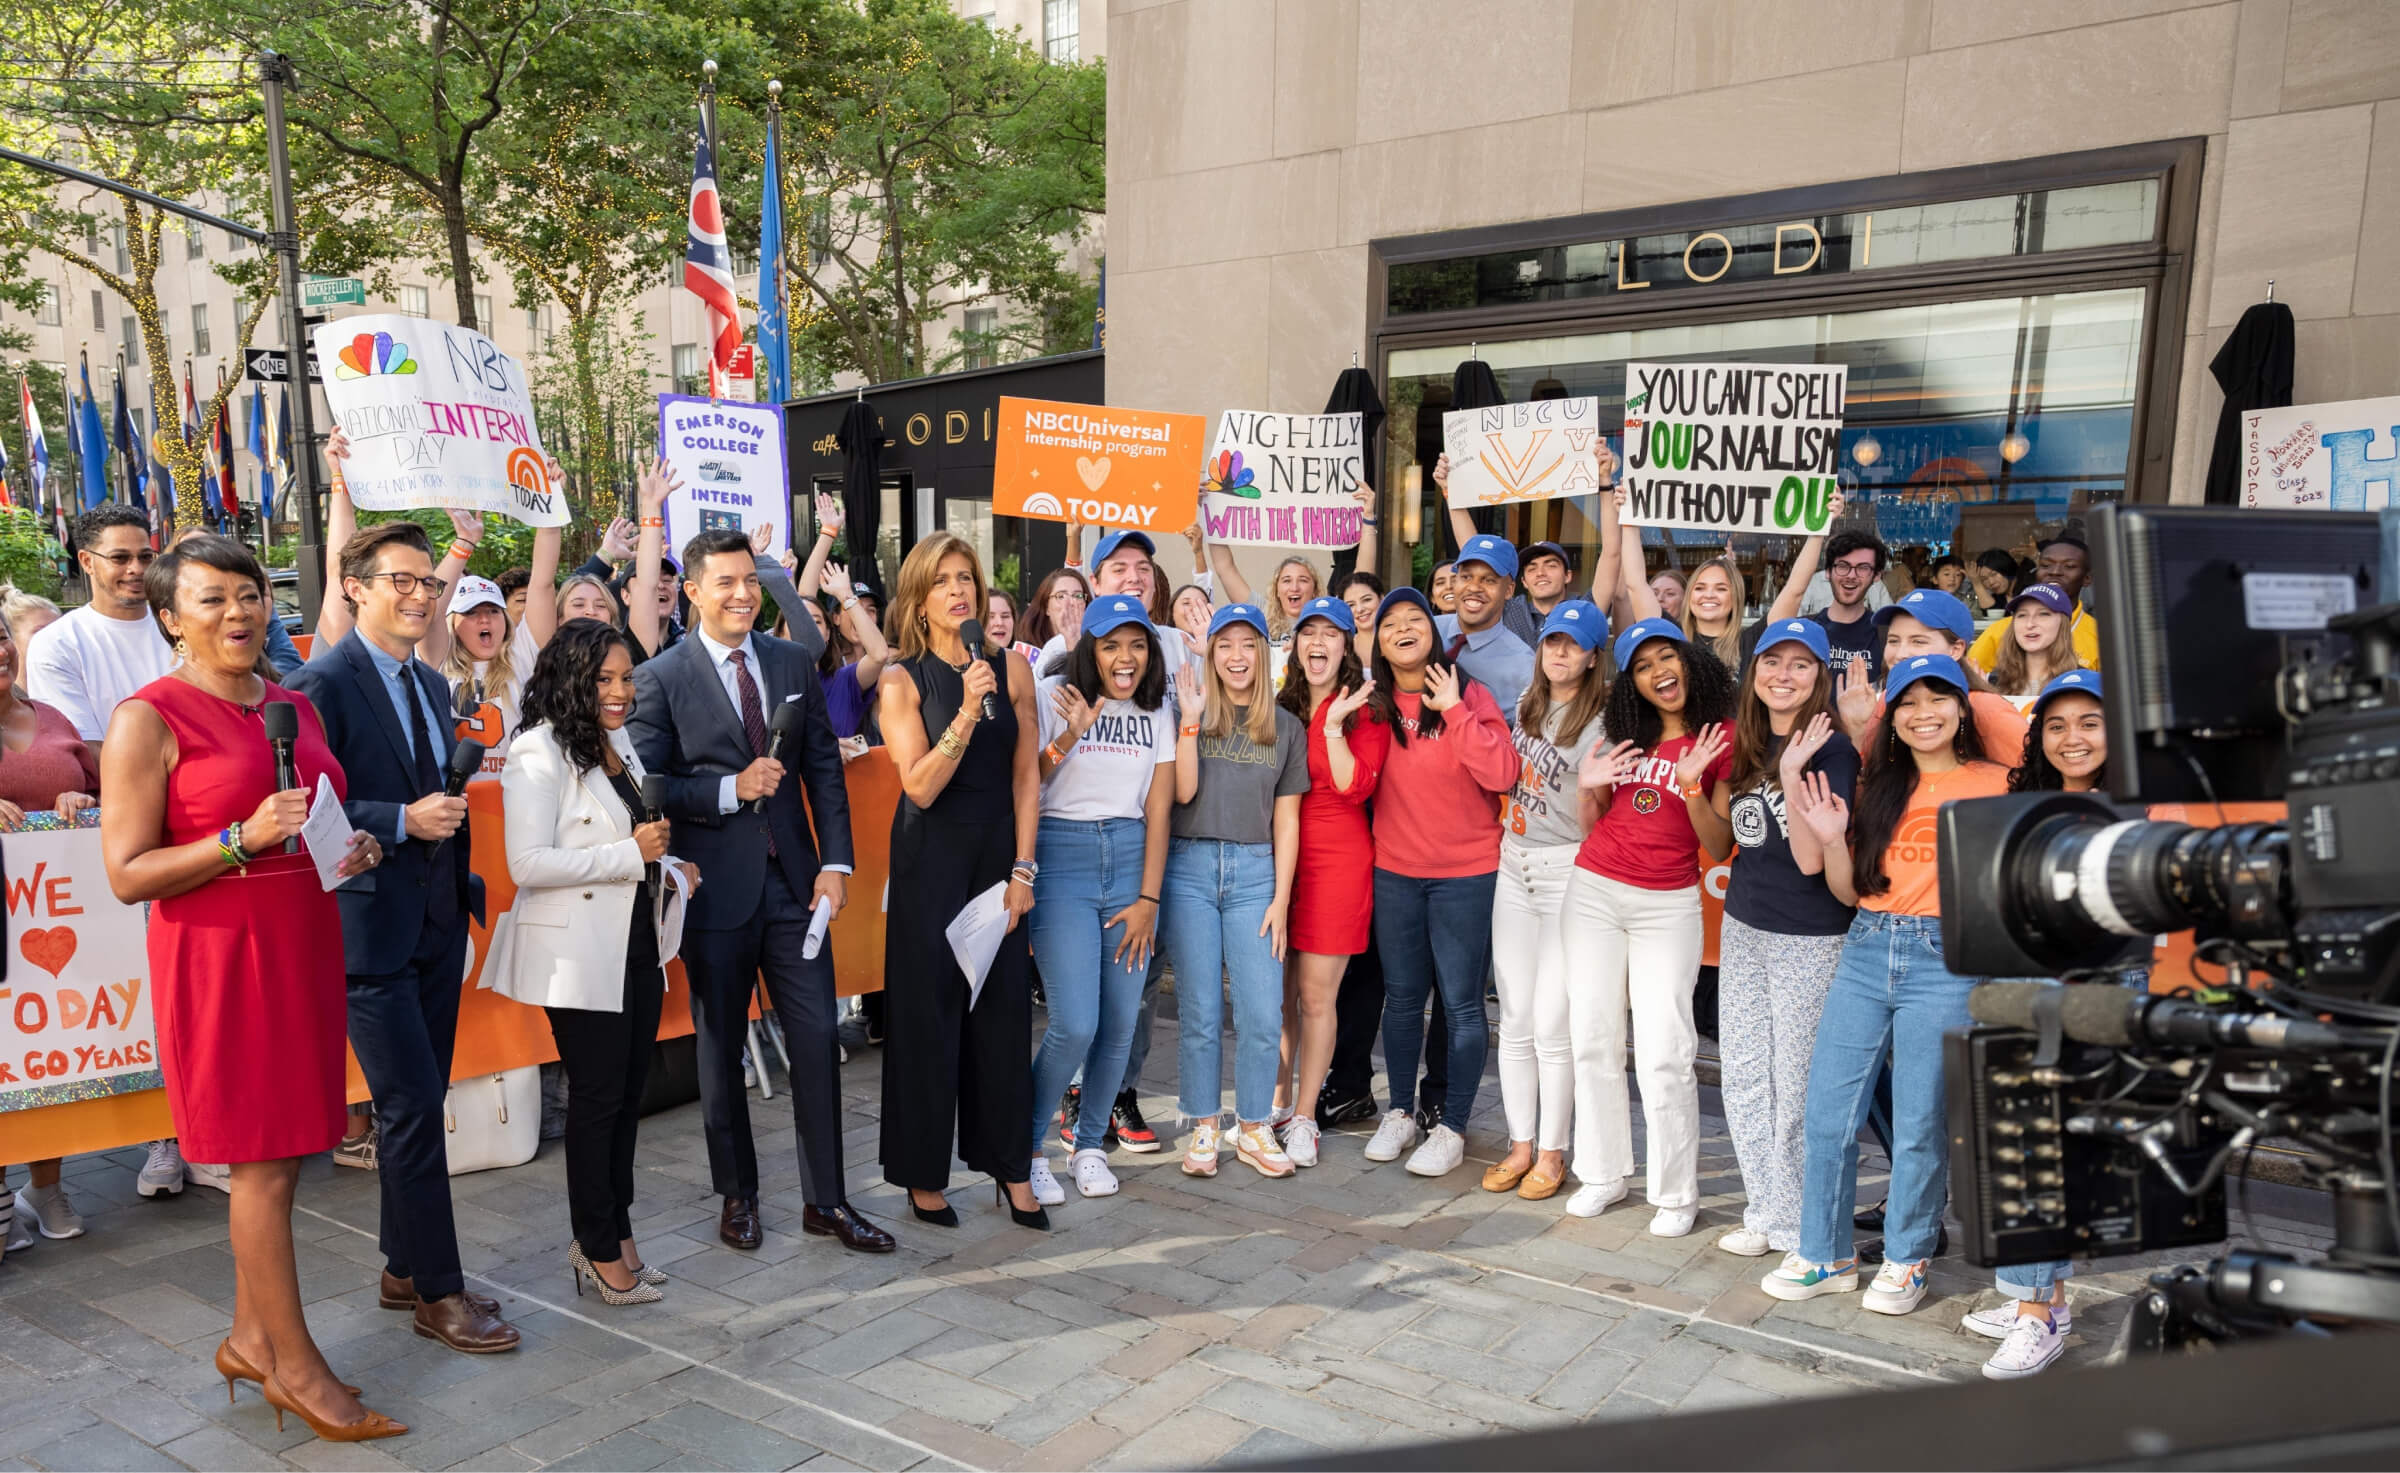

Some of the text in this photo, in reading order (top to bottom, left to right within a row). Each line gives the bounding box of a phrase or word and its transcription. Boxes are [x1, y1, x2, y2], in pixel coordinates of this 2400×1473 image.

[1617, 215, 1873, 290] LODI
[306, 280, 353, 296] ROCKEFELLER
[260, 360, 285, 373] ONE
[444, 330, 517, 395] NBC
[1638, 367, 1699, 416] YOU
[1770, 371, 1844, 421] SPELL
[336, 400, 531, 447] NATIONAL INTERN
[675, 413, 764, 440] EMERSON
[1024, 410, 1171, 442] NBCUniversal
[1221, 412, 1361, 449] NIGHTLY
[1481, 398, 1588, 433] NBCU
[393, 436, 446, 466] DAY
[682, 436, 759, 456] COLLEGE
[1025, 430, 1167, 458] internship program
[1628, 419, 1843, 476] JOURNALISM
[1268, 453, 1361, 495] NEWS
[510, 483, 553, 514] TODAY
[691, 488, 753, 507] INTERN
[1066, 497, 1158, 526] TODAY
[1628, 476, 1773, 527] WITHOUT
[1772, 475, 1838, 532] OU
[1203, 503, 1262, 540] WITH
[1265, 505, 1298, 544] THE
[1067, 714, 1153, 749] WARD
[1079, 745, 1140, 758] UNIVERSITY
[1613, 756, 1686, 801] EMPL
[4, 861, 84, 918] WE
[23, 1049, 69, 1081] 60
[73, 1039, 153, 1074] YEARS
